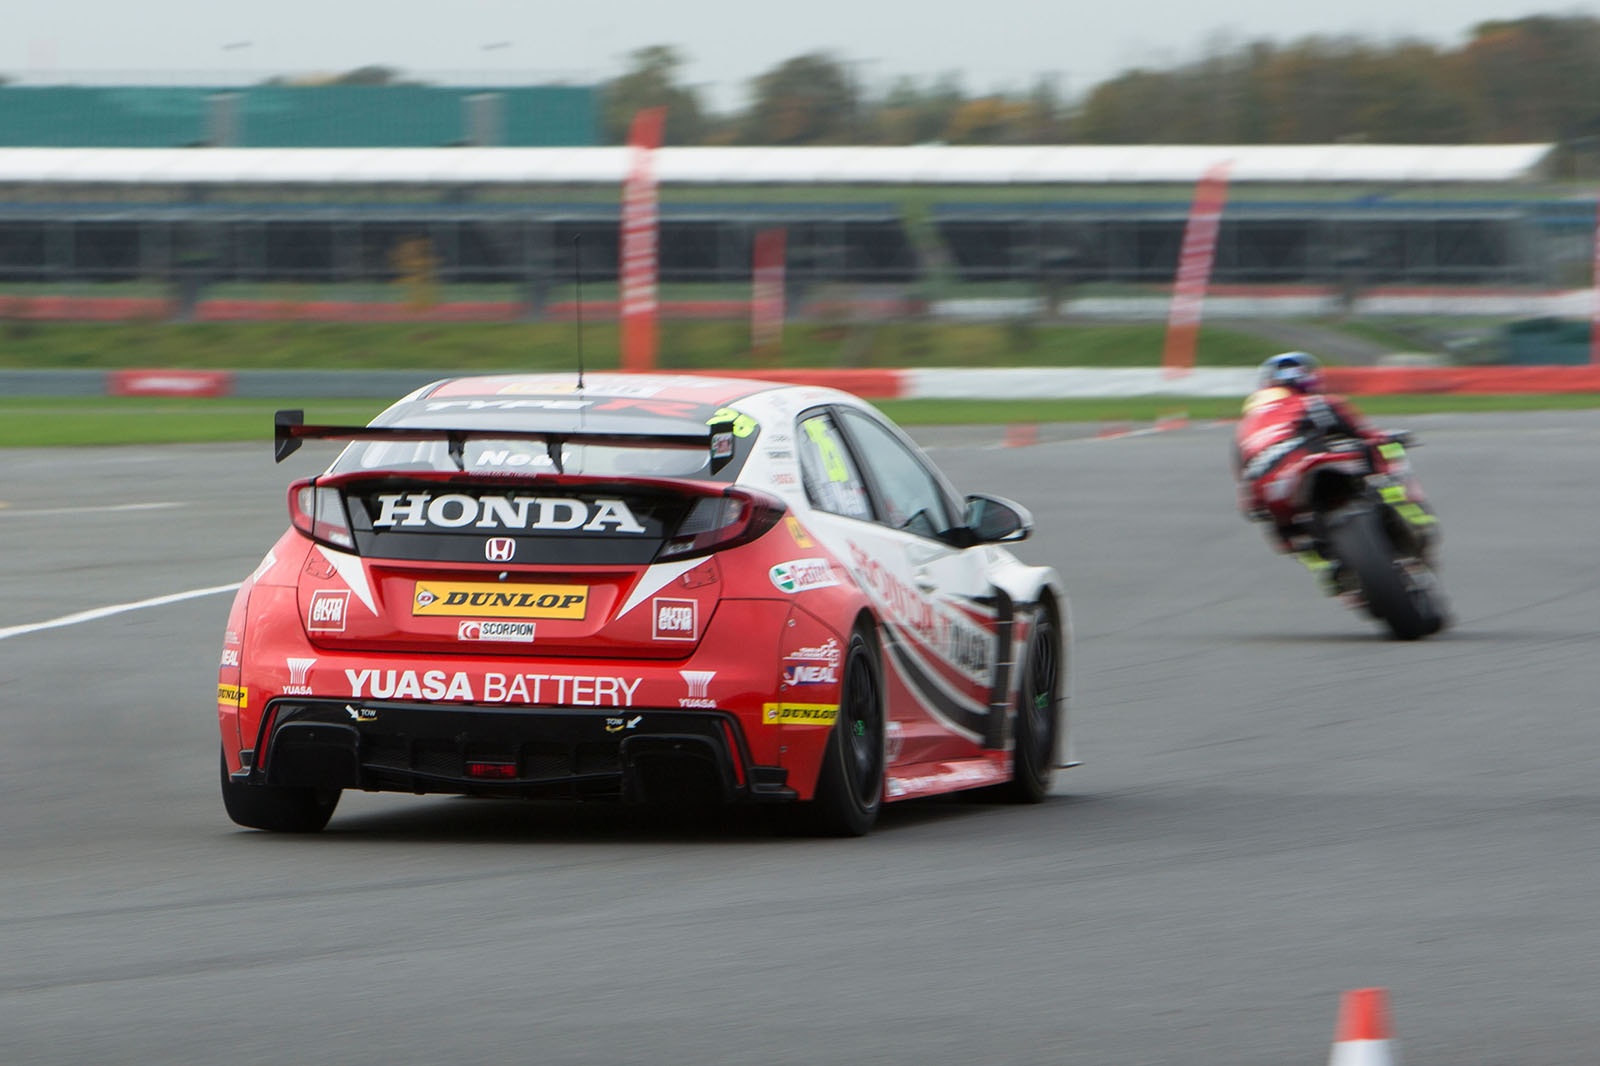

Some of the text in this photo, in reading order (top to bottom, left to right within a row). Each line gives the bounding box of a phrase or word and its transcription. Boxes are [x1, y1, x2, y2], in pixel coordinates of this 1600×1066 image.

[373, 493, 646, 533] HONDA
[314, 598, 344, 611] AUTO
[442, 591, 585, 609] DUNLOP
[312, 609, 342, 622] GLYM
[660, 607, 692, 618] AUTO
[482, 622, 534, 636] SCORPION
[282, 685, 313, 696] YUASA
[344, 669, 643, 707] YUASA BATTERY
[678, 698, 717, 709] YUASA
[360, 709, 377, 717] TOW
[605, 718, 624, 727] TOW
